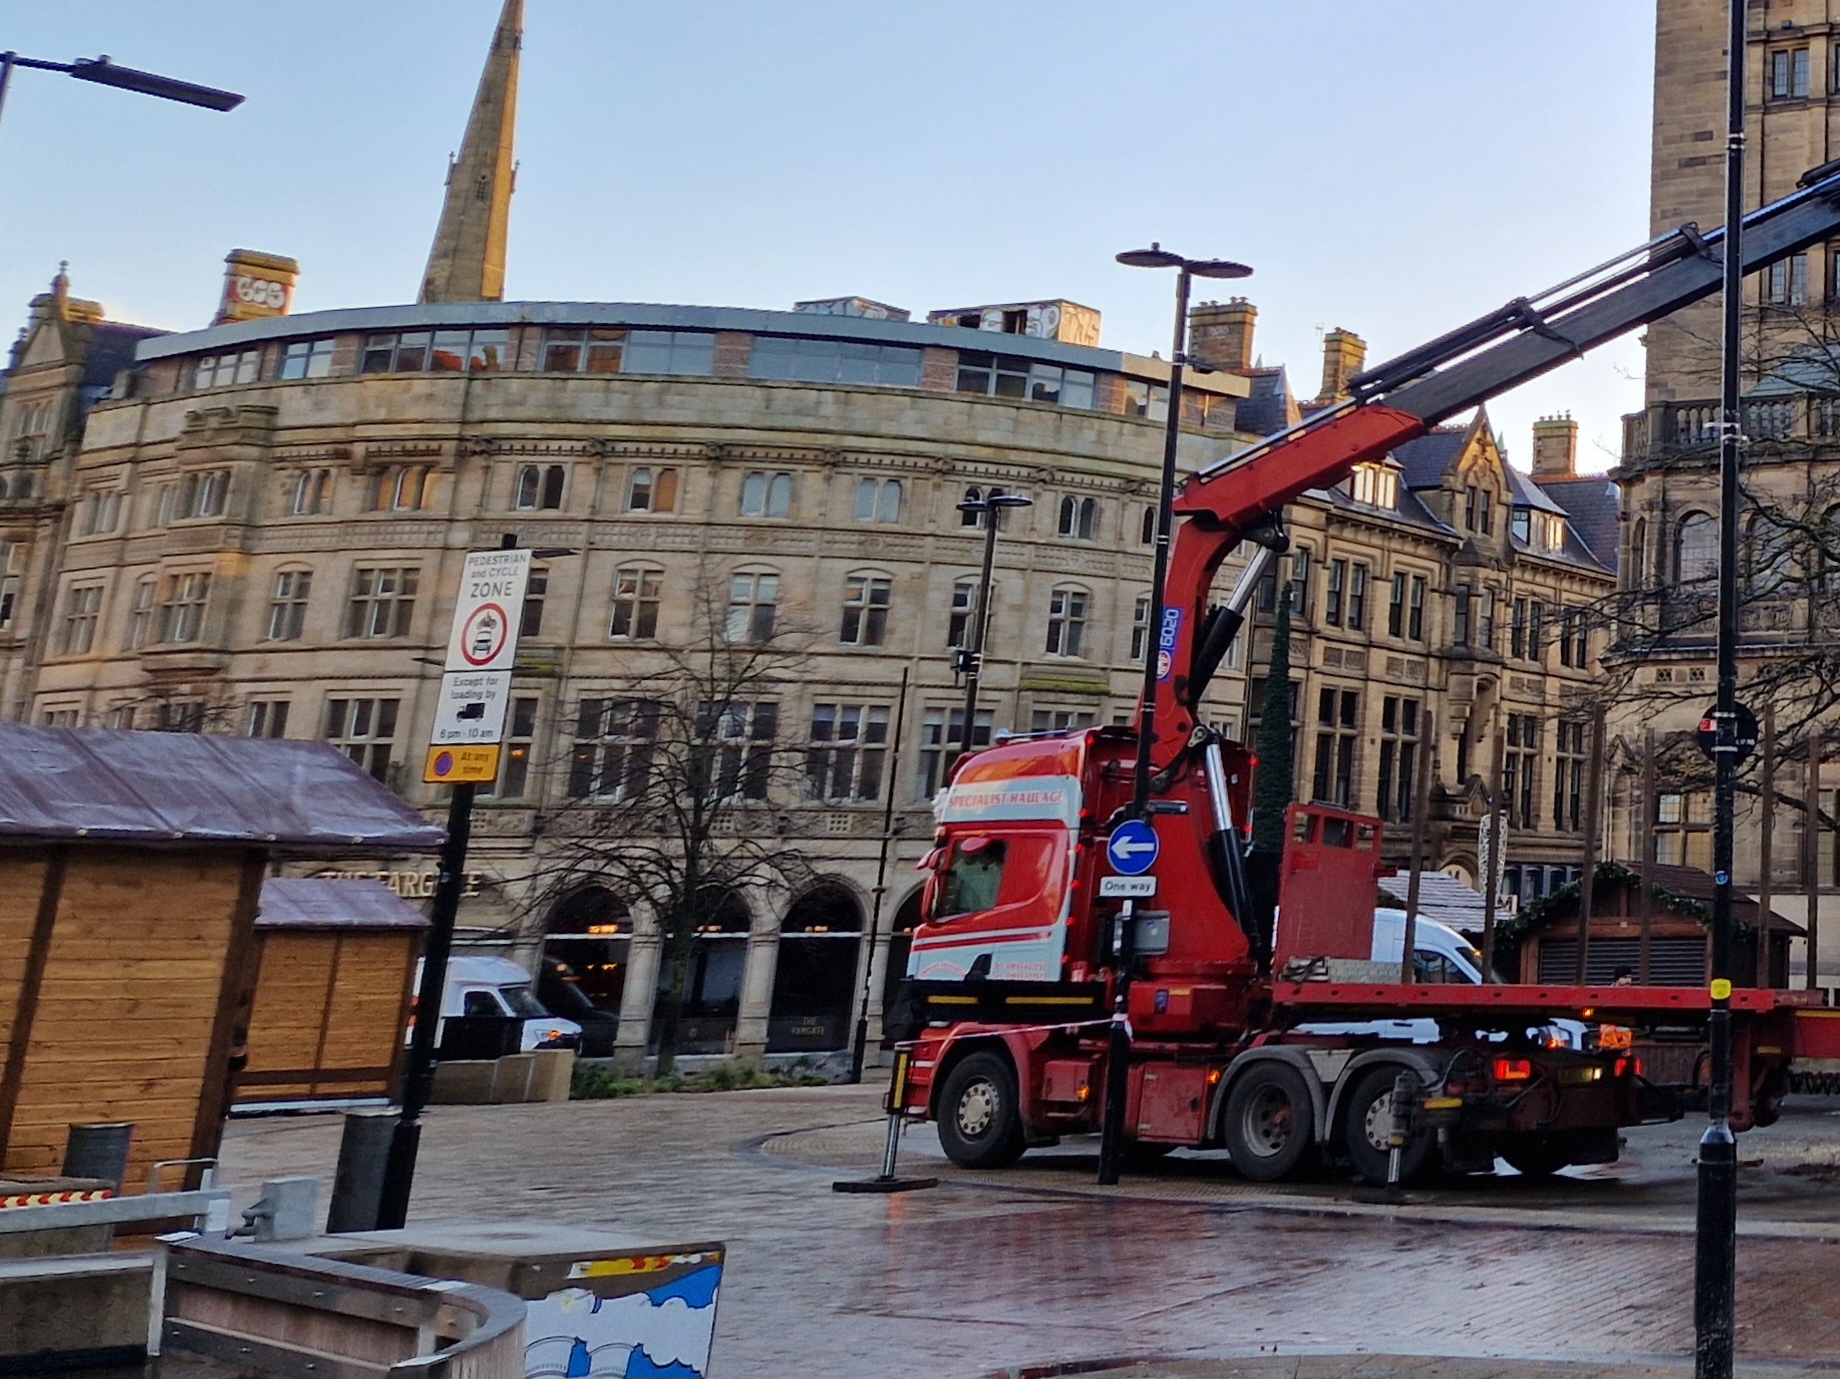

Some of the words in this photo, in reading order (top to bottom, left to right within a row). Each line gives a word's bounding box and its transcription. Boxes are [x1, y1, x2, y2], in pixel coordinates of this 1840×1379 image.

[468, 554, 527, 567] PEDESTRIAN
[471, 569, 487, 579] and
[489, 567, 519, 578] CYCLE
[470, 581, 514, 598] ZONE
[1160, 609, 1179, 646] 6020
[453, 677, 483, 687] Except
[486, 676, 499, 685] for
[451, 690, 483, 700] loading
[486, 690, 497, 700] by
[468, 728, 478, 738] 10
[480, 730, 494, 738] am
[461, 752, 471, 761] At
[474, 753, 489, 763] any
[950, 793, 1007, 807] SPECIALIST
[1010, 790, 1065, 805] HAULAGE
[1105, 881, 1126, 891] One
[1130, 883, 1151, 893] way
